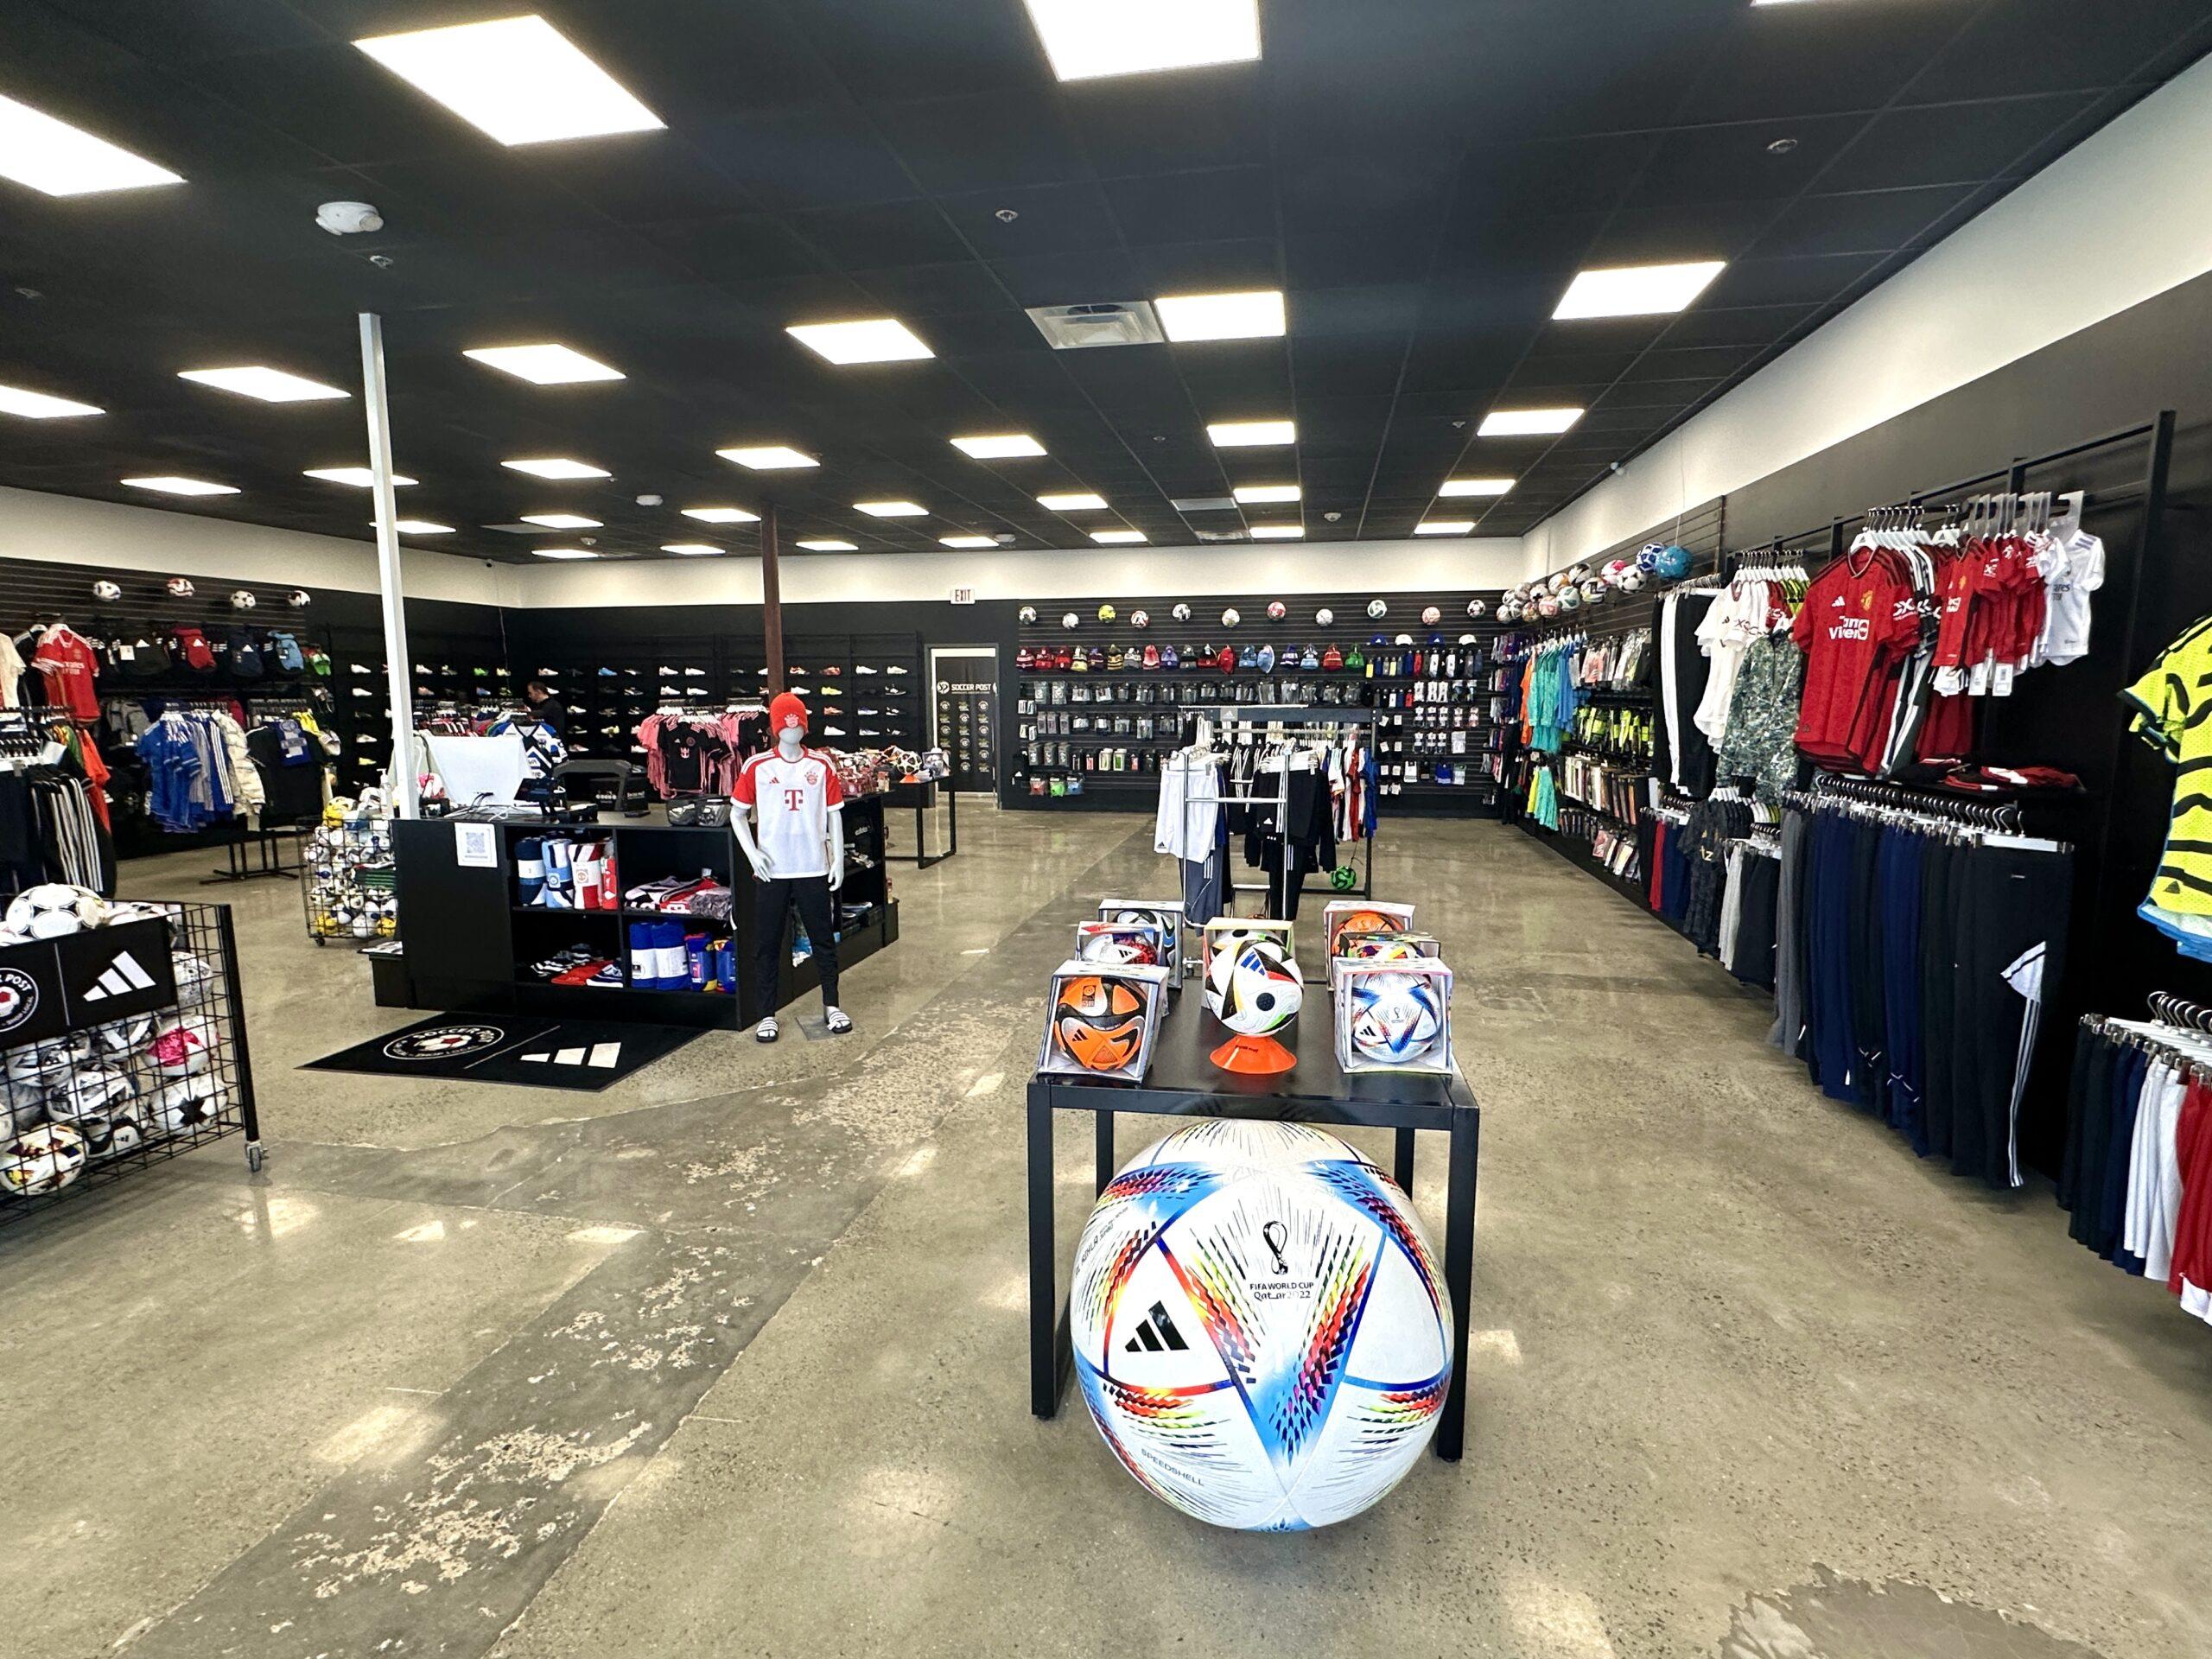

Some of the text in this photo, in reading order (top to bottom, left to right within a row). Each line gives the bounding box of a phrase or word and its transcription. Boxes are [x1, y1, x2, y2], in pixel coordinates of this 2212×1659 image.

[955, 589, 971, 602] EXIT
[785, 789, 804, 811] T
[5, 973, 33, 991] POST
[412, 1027, 480, 1039] SOCCER
[1268, 1281, 1297, 1290] WORLD
[1141, 1447, 1205, 1487] SPEEDSHELL
